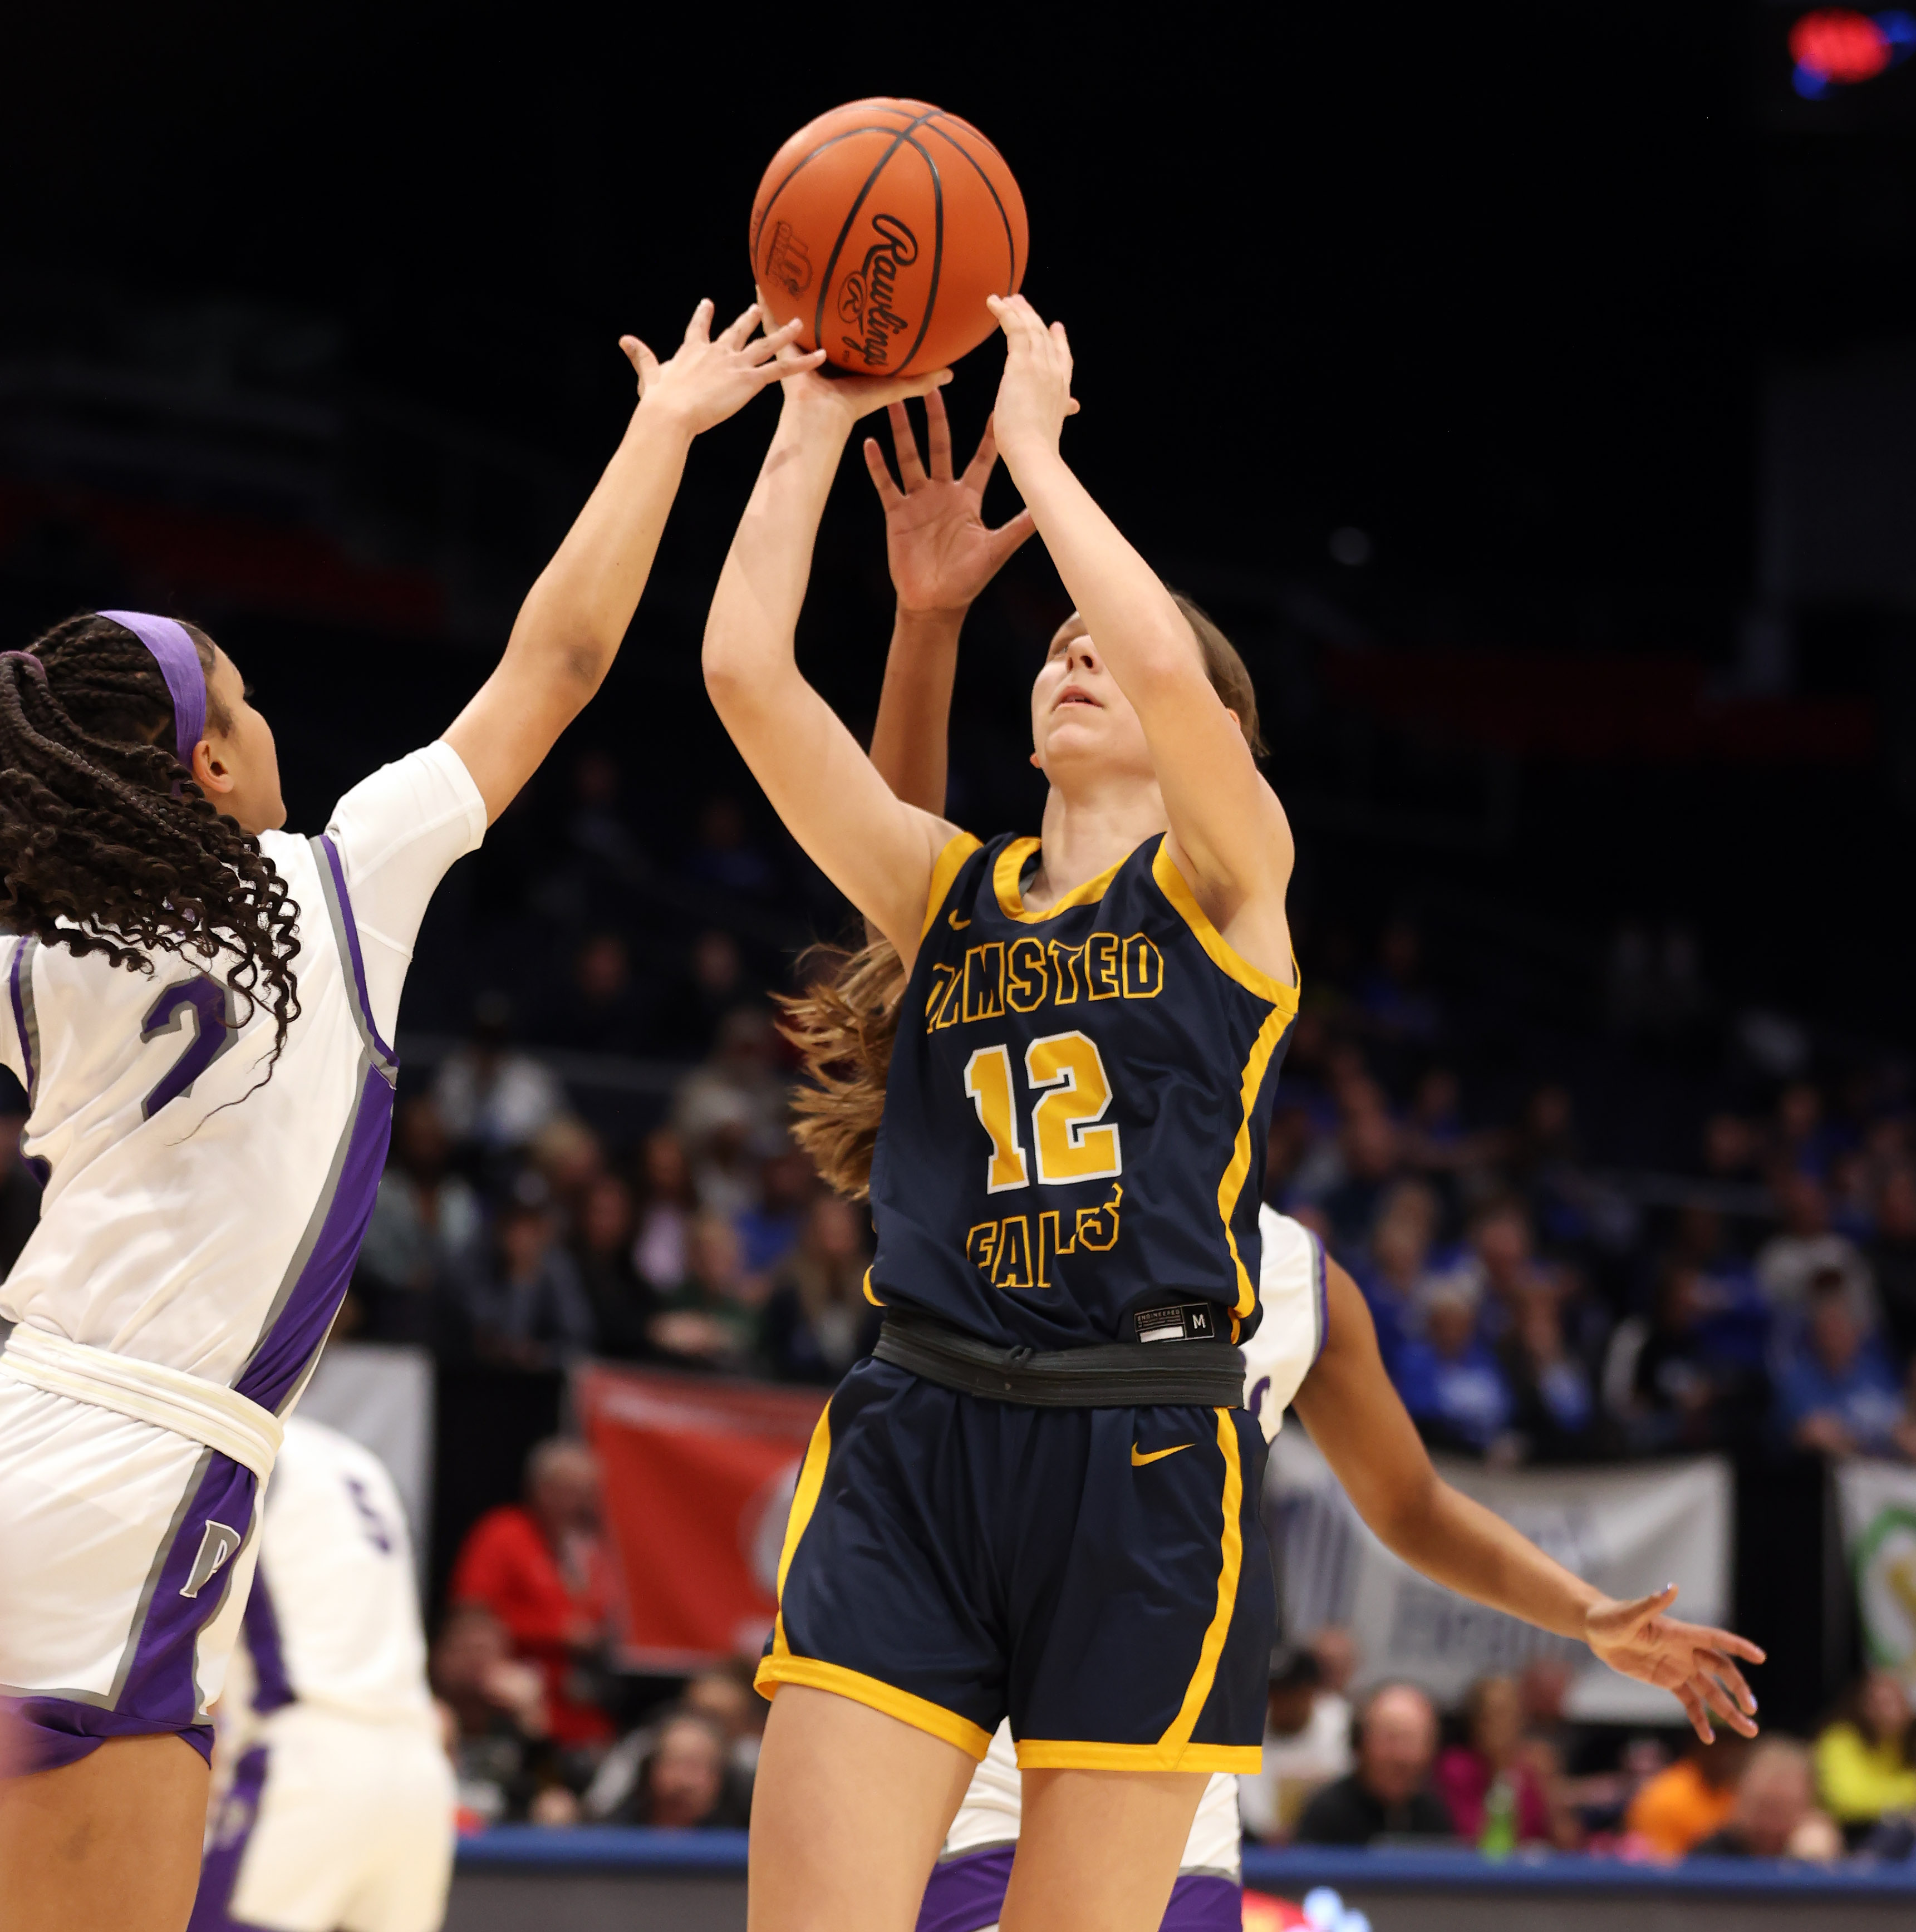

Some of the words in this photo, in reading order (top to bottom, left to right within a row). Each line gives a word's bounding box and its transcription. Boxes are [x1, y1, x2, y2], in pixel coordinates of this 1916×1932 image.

[841, 214, 918, 366] Rawlings
[963, 1030, 1122, 1195] 12
[1192, 1313, 1206, 1330] M
[179, 1519, 241, 1599] P
